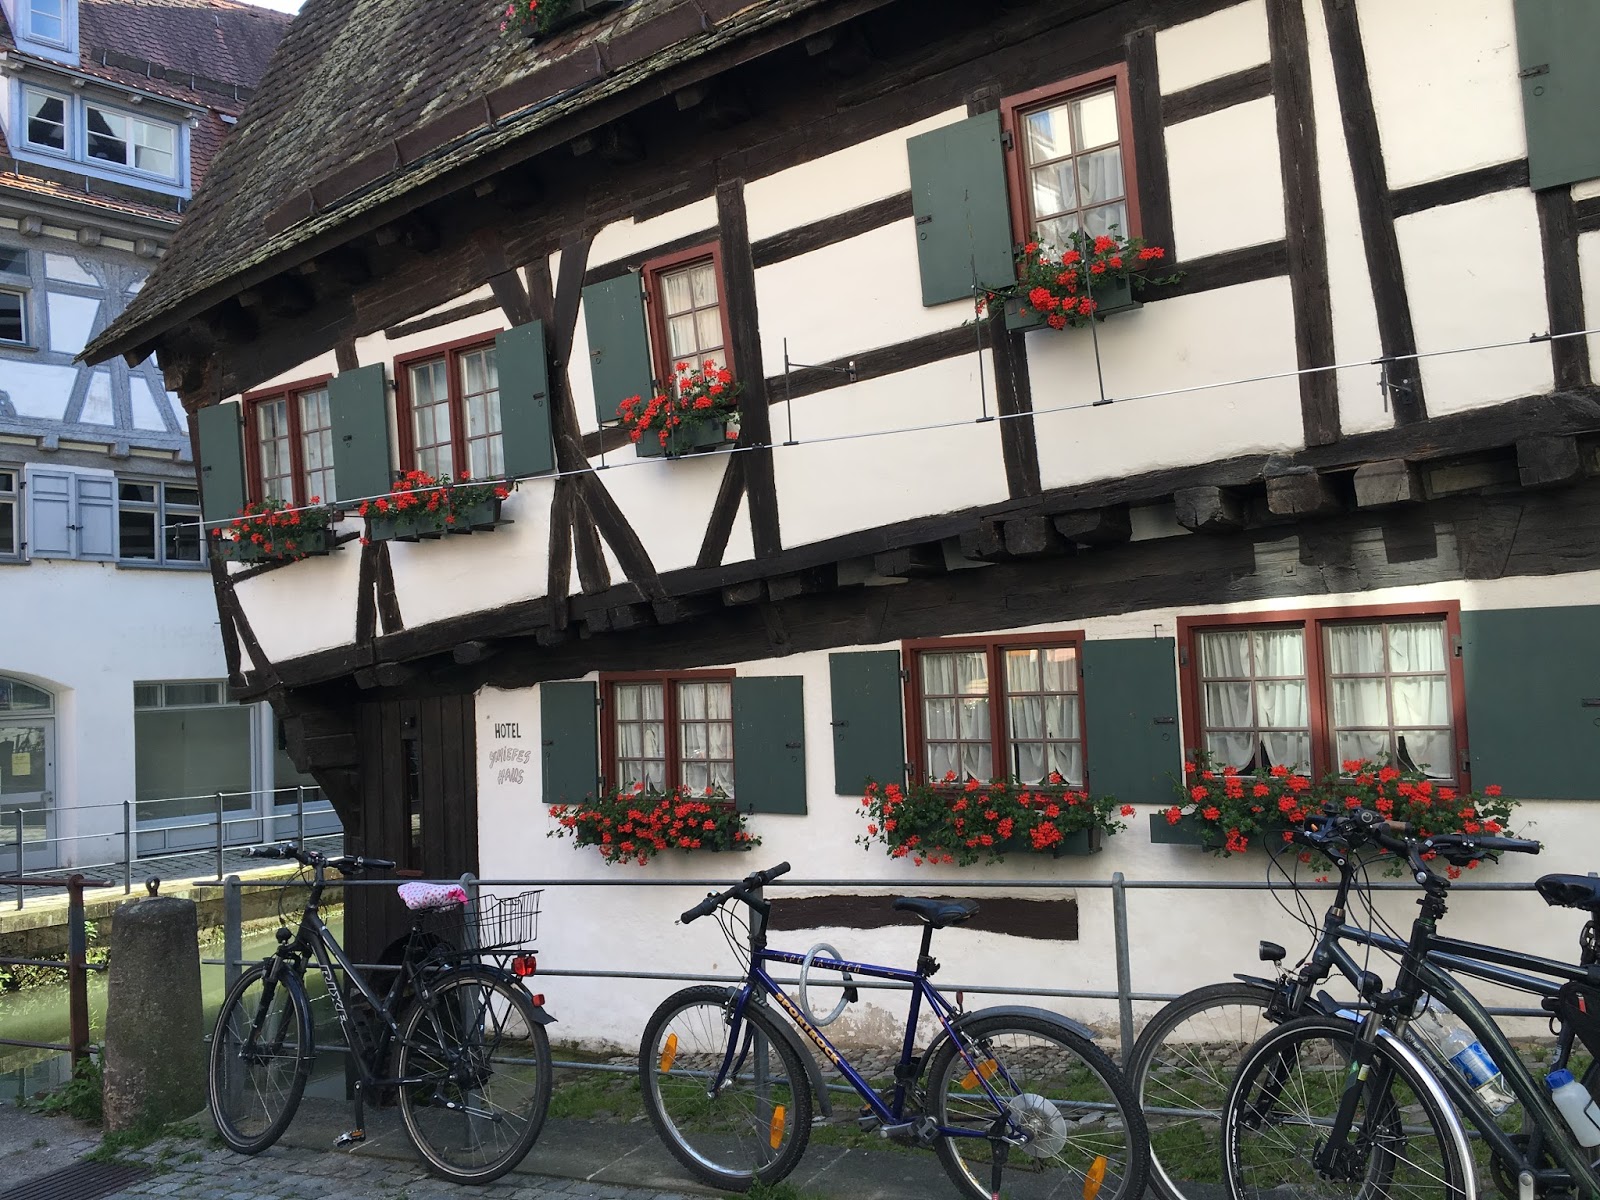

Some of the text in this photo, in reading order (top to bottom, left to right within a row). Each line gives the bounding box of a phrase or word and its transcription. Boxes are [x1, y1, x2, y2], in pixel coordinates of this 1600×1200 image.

[494, 722, 522, 739] HOTEL
[782, 953, 862, 973] SPEIALIZED
[775, 992, 840, 1065] SPORTROCK
